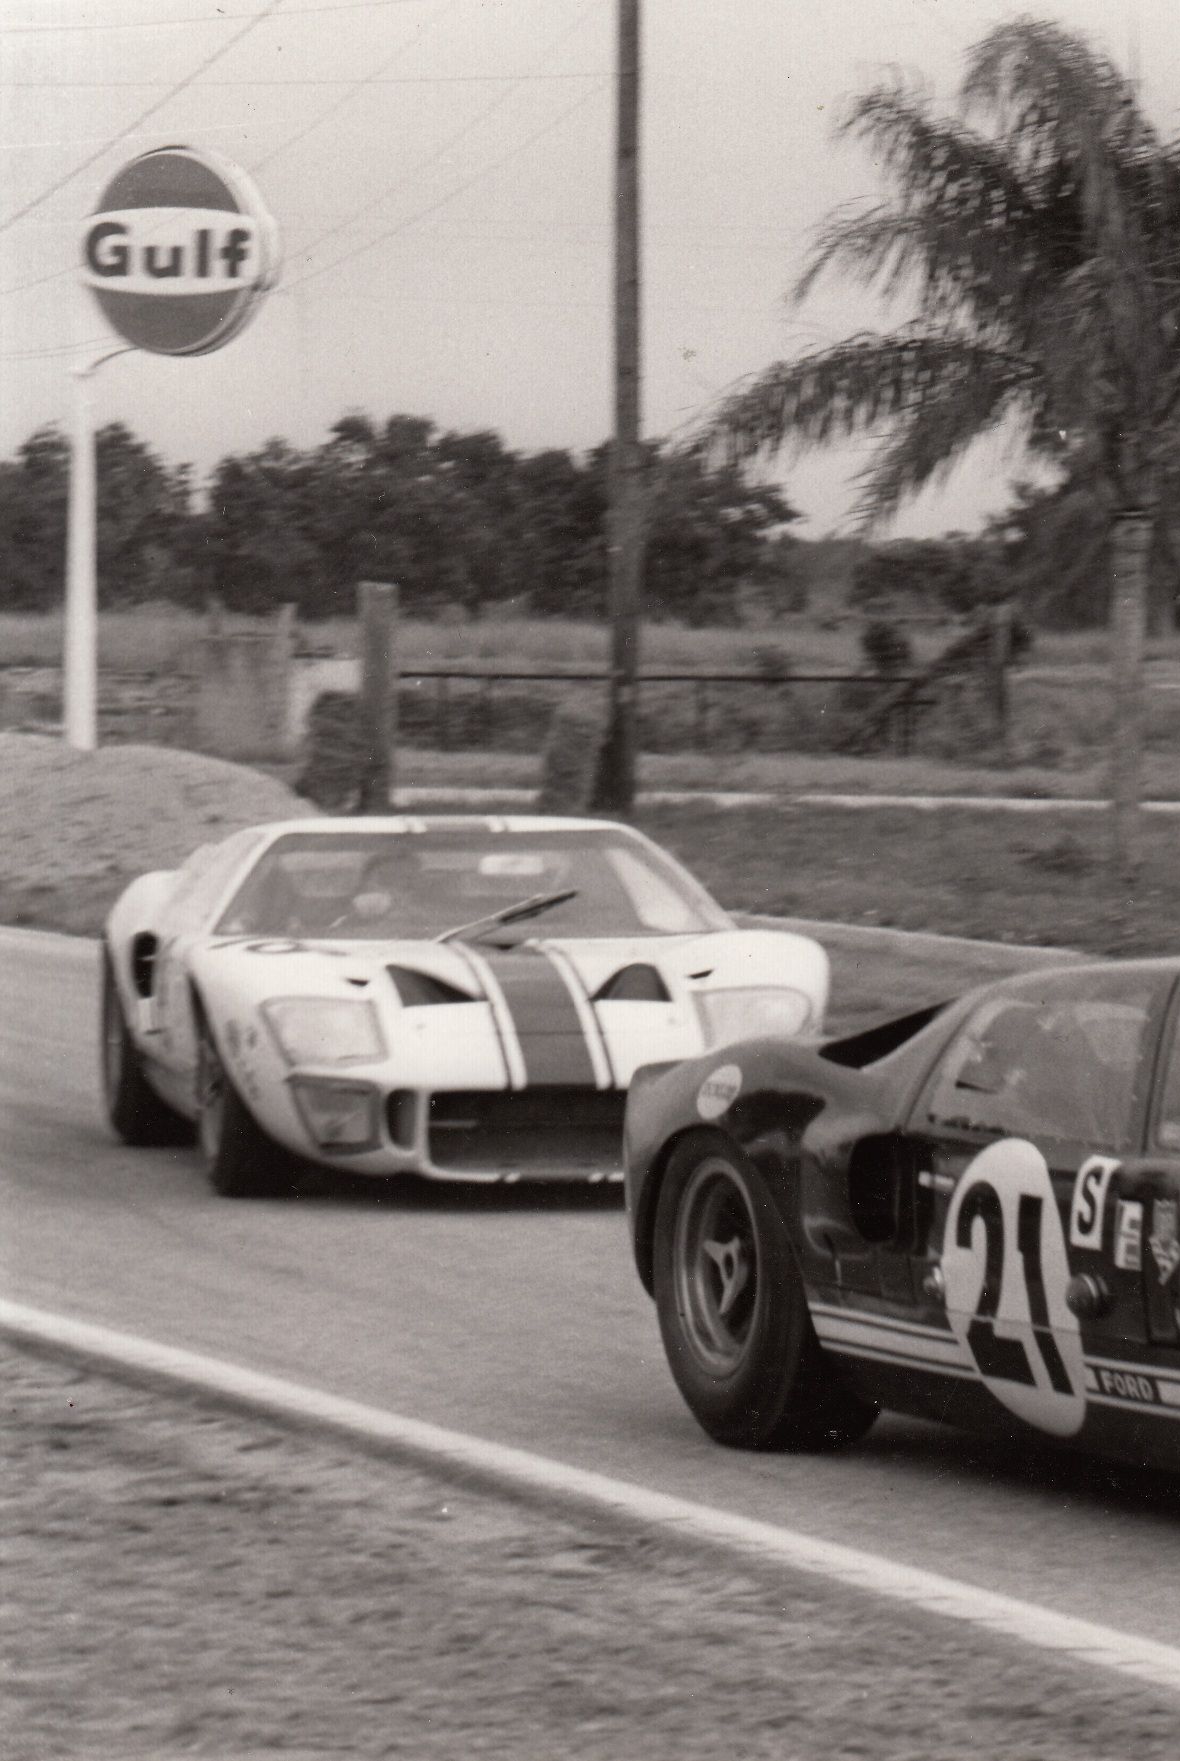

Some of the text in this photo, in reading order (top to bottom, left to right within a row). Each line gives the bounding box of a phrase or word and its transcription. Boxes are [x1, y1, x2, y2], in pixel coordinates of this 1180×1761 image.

[86, 221, 250, 279] Gulf
[1076, 1164, 1105, 1236] S
[955, 1179, 1077, 1398] 21
[1099, 1370, 1154, 1402] FORD
